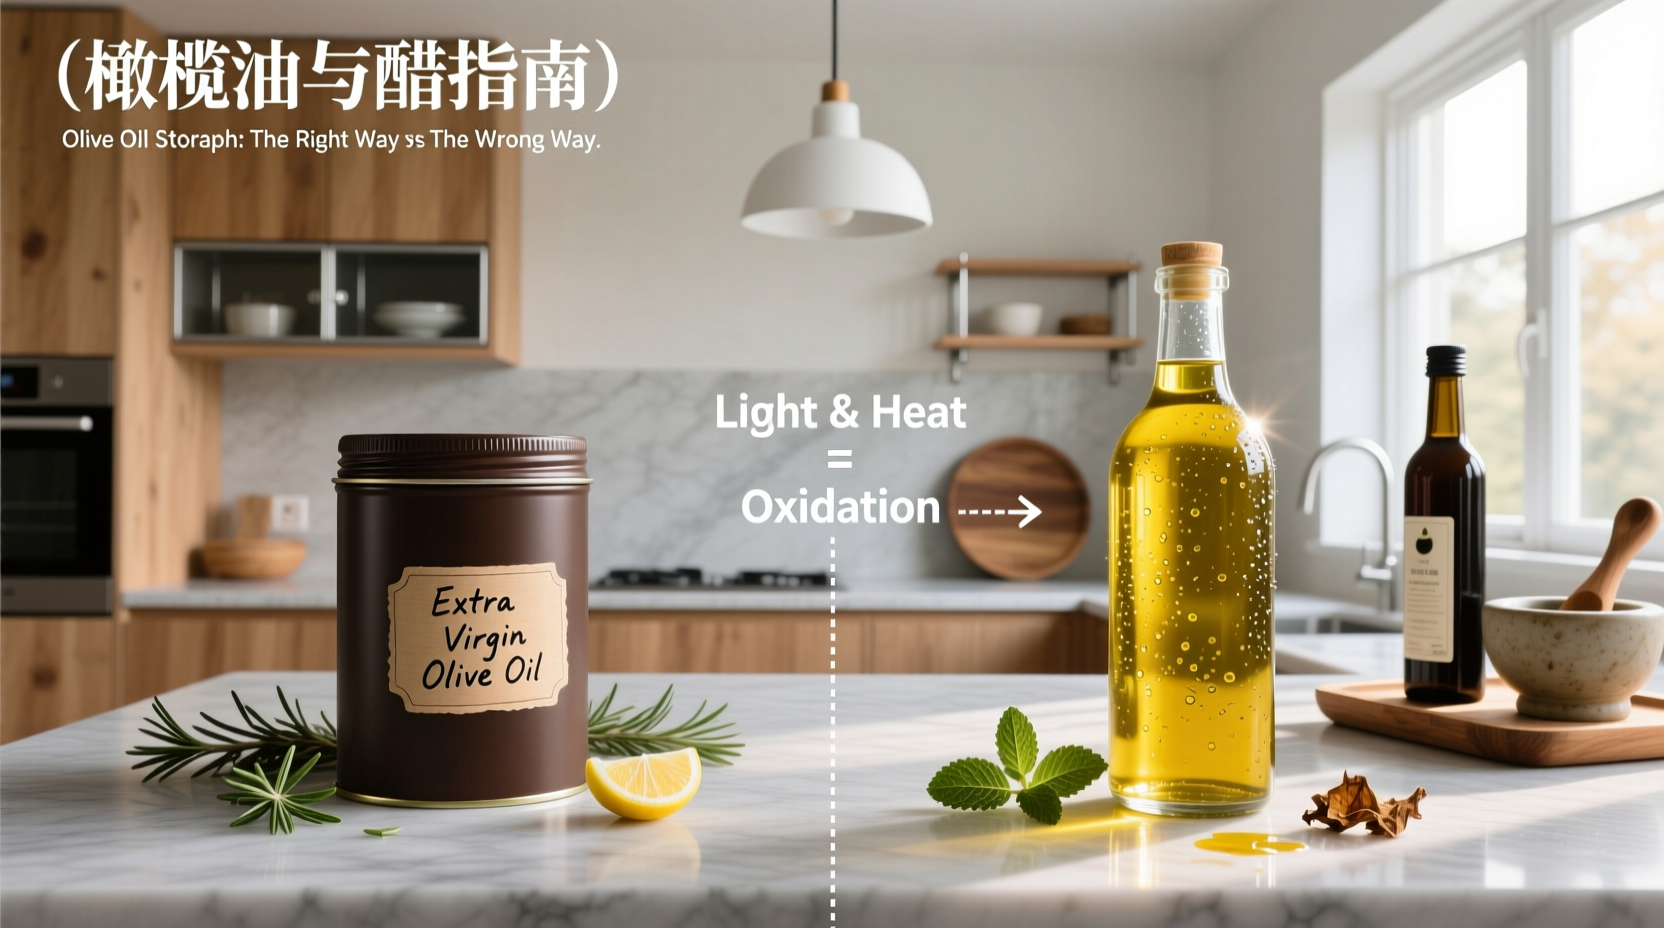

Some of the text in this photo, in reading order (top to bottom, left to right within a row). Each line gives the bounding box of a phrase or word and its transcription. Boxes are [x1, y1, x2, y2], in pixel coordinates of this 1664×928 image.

[431, 585, 516, 617] Extra
[444, 623, 527, 662] Virgin
[422, 651, 543, 690] Olive Oil
